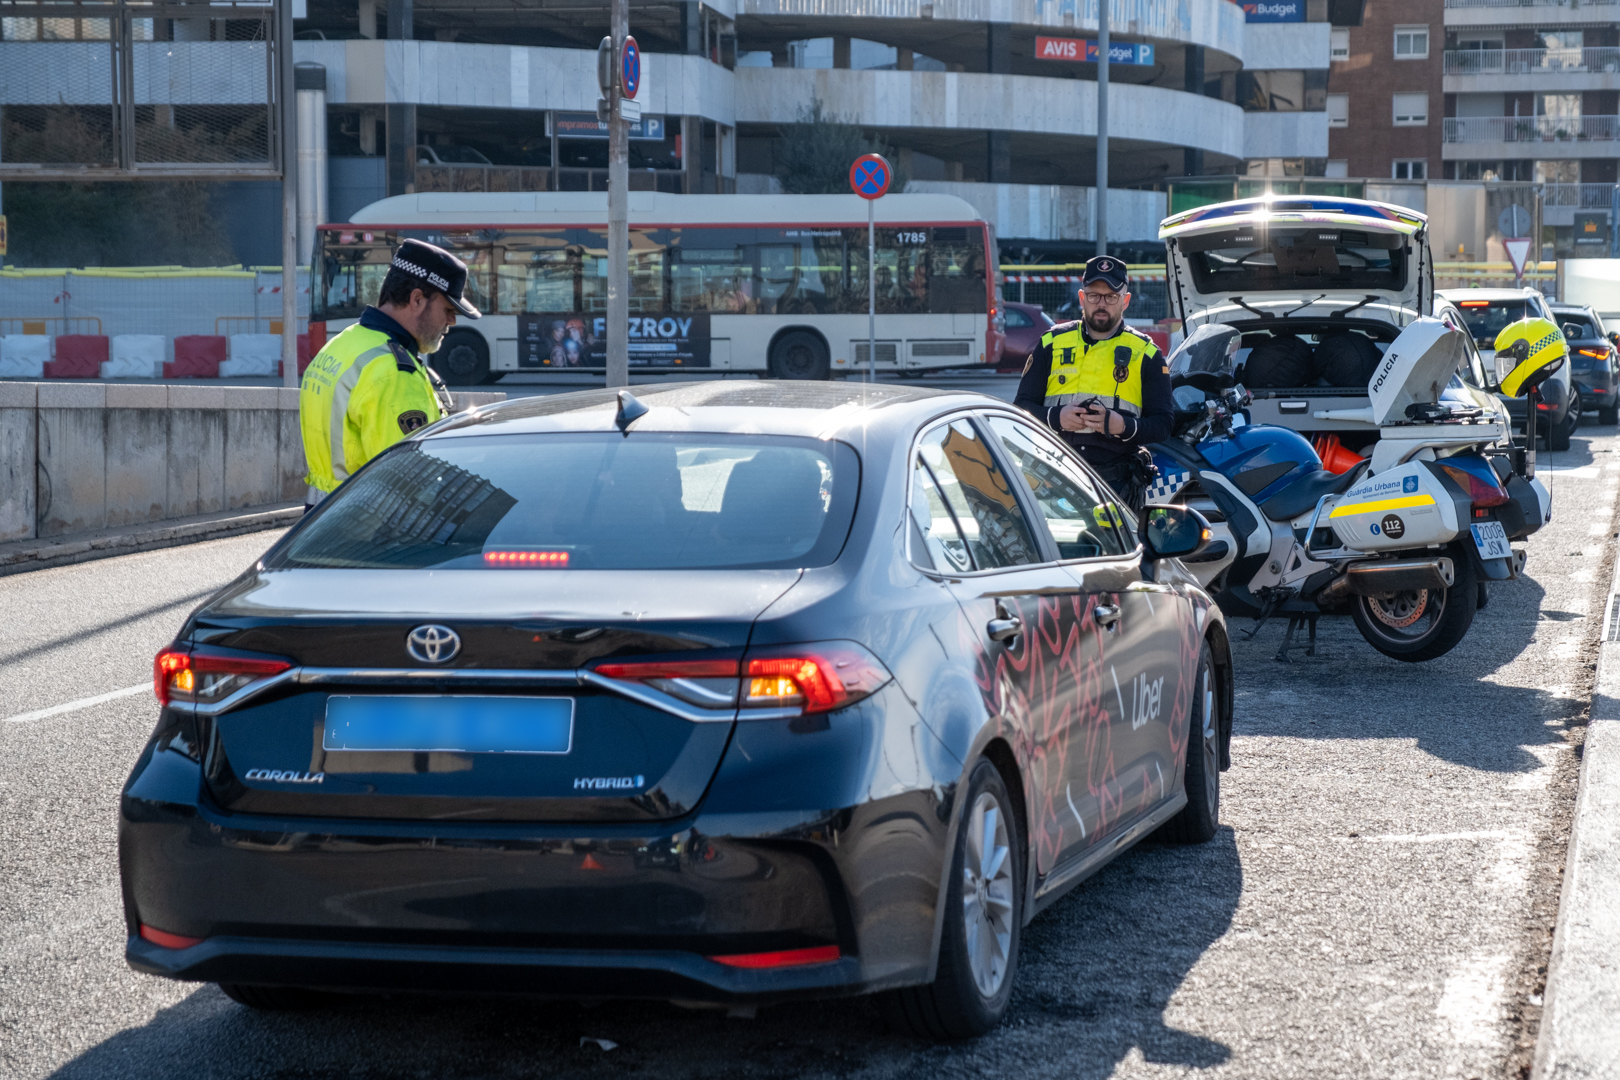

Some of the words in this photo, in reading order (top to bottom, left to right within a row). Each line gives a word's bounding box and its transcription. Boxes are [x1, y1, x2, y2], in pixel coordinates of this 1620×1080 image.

[1258, 3, 1296, 17] Budget
[1043, 41, 1077, 57] AVIS
[1108, 46, 1133, 61] udget
[1139, 44, 1151, 63] P
[648, 119, 659, 136] P
[897, 232, 926, 243] 1785
[593, 317, 693, 338] FZROY
[1052, 367, 1078, 376] POLICIA
[1372, 353, 1399, 393] POLICIA
[1374, 481, 1401, 492] Urbana
[1385, 520, 1401, 530] 112
[1478, 524, 1505, 540] 2008
[1132, 672, 1164, 731] Uber
[245, 768, 325, 784] COROLLA
[573, 777, 633, 789] HYBRID
